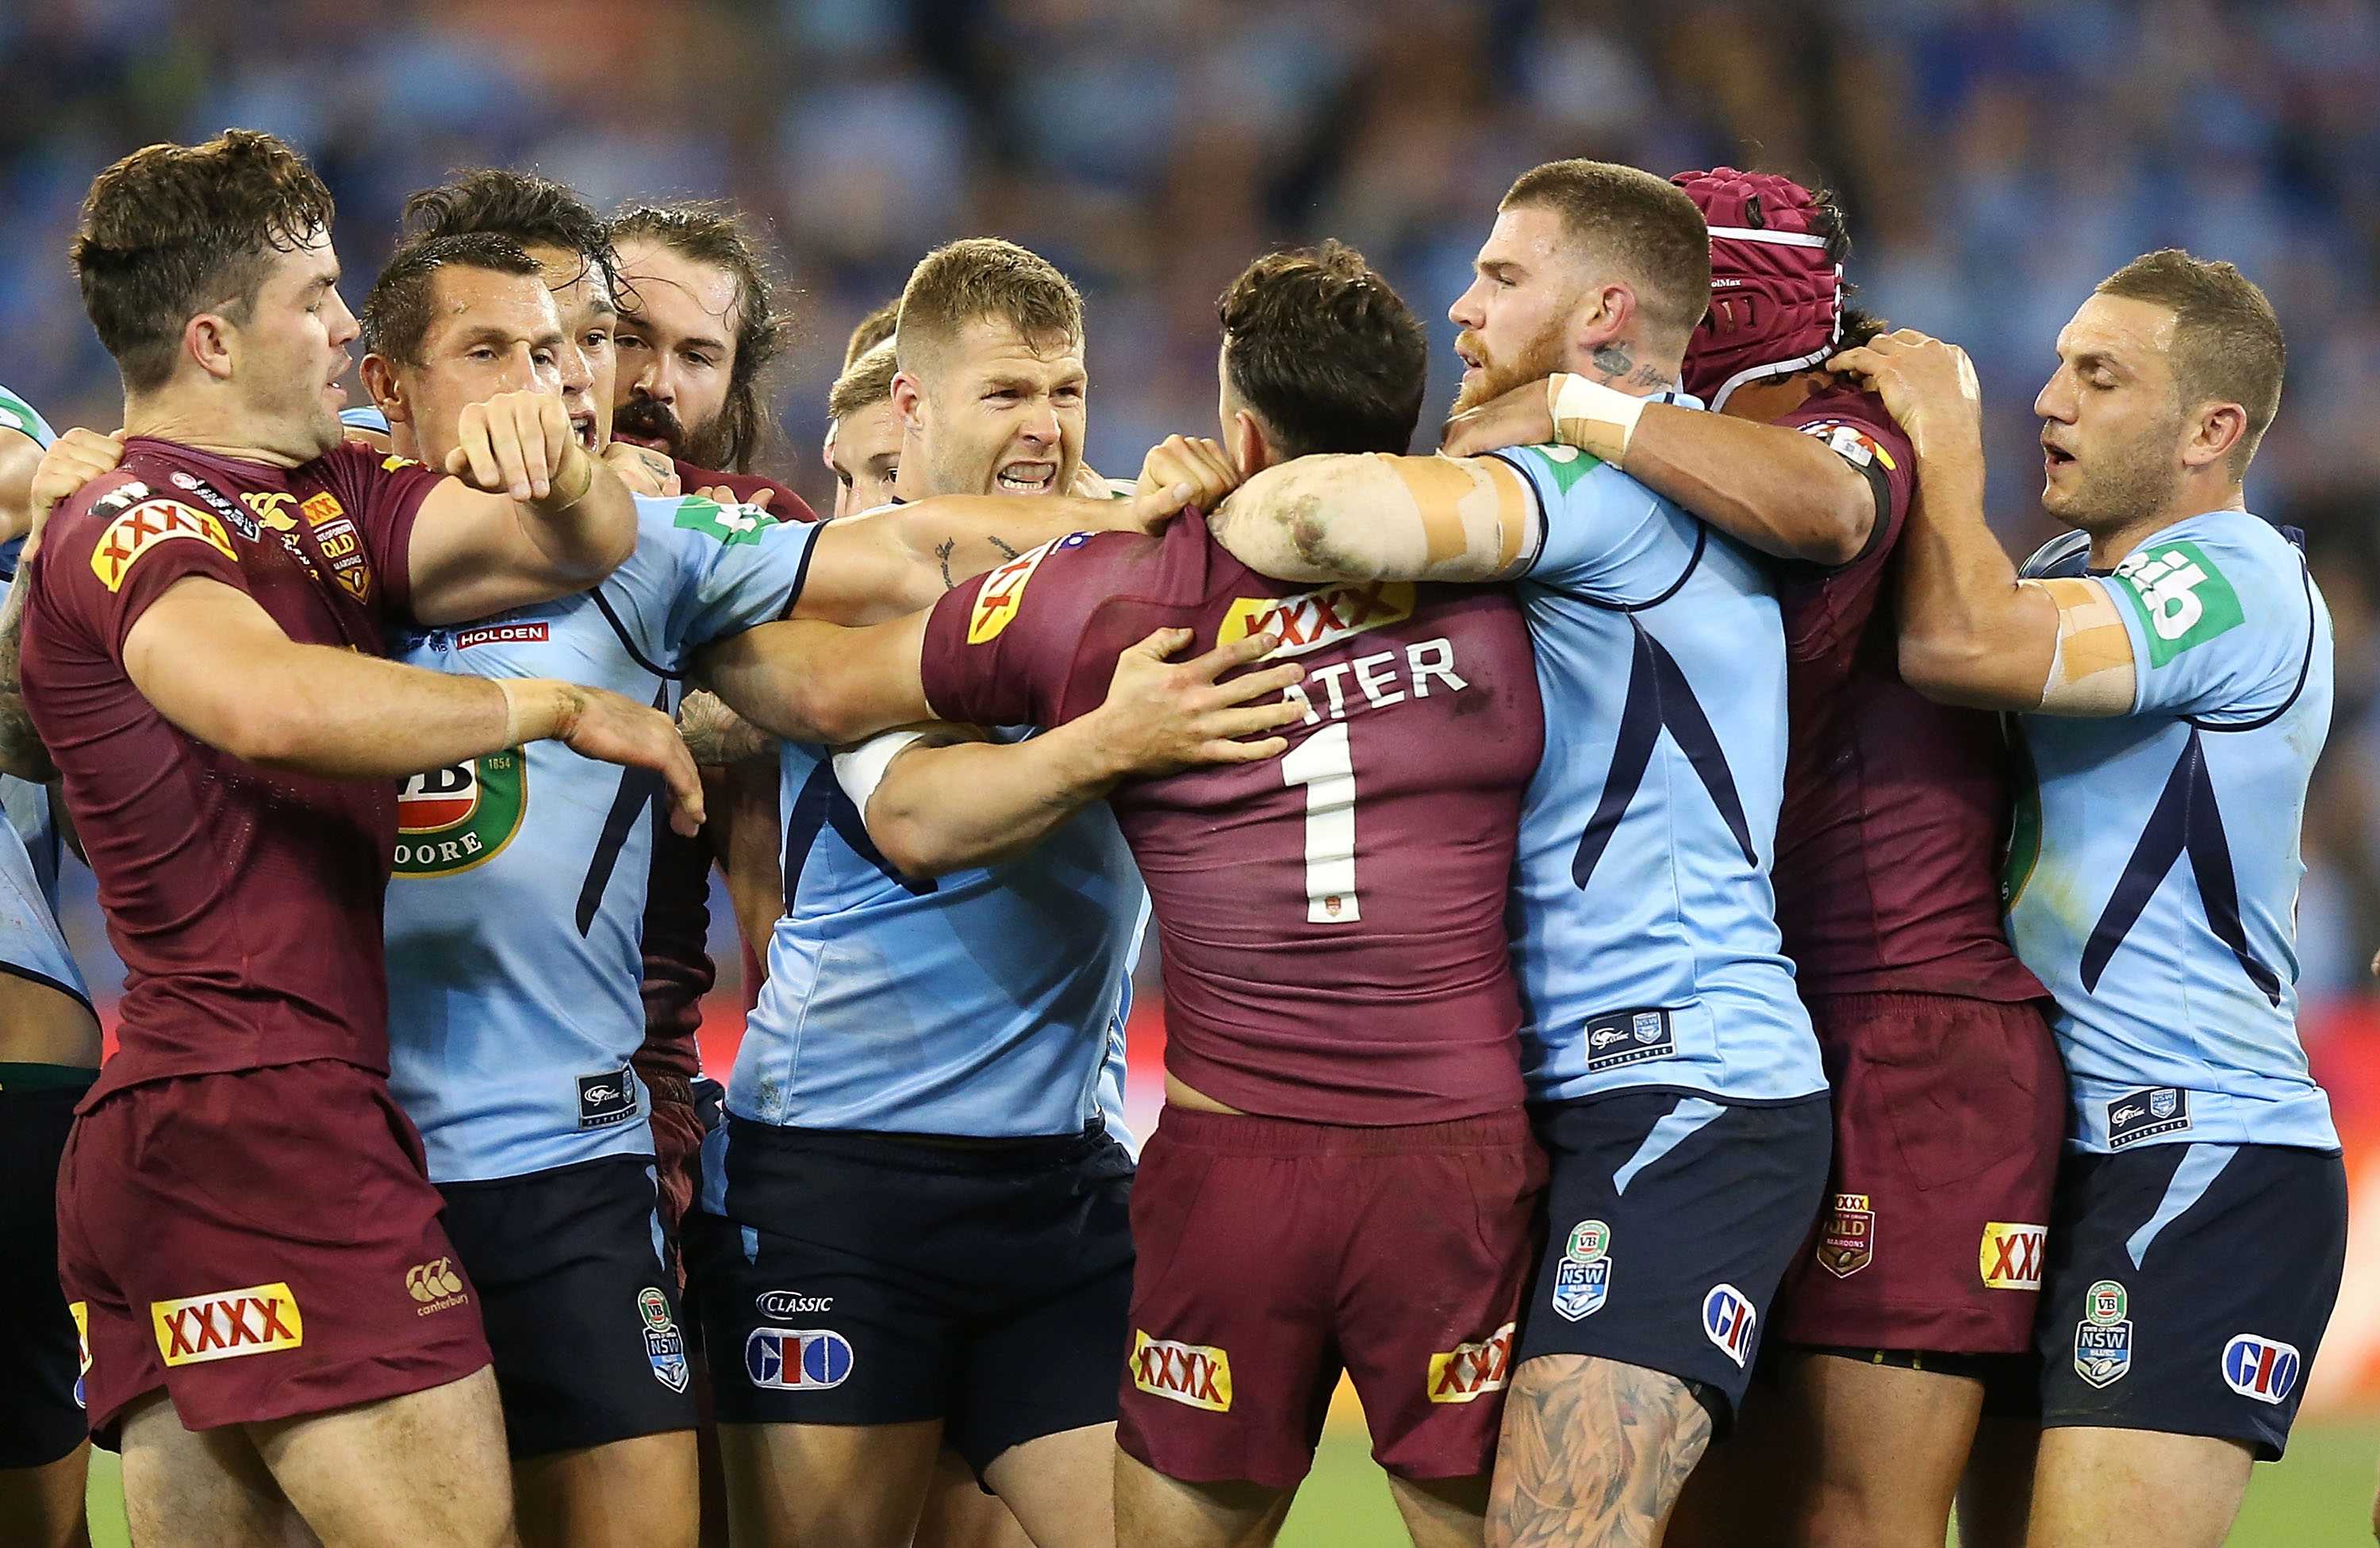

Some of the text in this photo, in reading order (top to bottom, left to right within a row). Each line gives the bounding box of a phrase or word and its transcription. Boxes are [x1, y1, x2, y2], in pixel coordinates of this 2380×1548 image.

[102, 505, 235, 582] XXXX
[321, 533, 355, 558] QLD
[1244, 586, 1403, 646] XXXX
[461, 627, 543, 646] HOLDEN
[488, 757, 511, 770] 1854
[1281, 722, 1361, 923] 1
[1580, 1237, 1598, 1246] VB
[1561, 1269, 1604, 1284] NSW
[648, 1304, 663, 1316] VB
[767, 1296, 834, 1312] CLASSIC
[2098, 1299, 2116, 1310] VB
[163, 1298, 296, 1358] XXXX
[651, 1339, 679, 1354] NSW
[2081, 1333, 2125, 1349] NSW
[1138, 1346, 1224, 1404] XXXX
[2226, 1341, 2297, 1398] GIO
